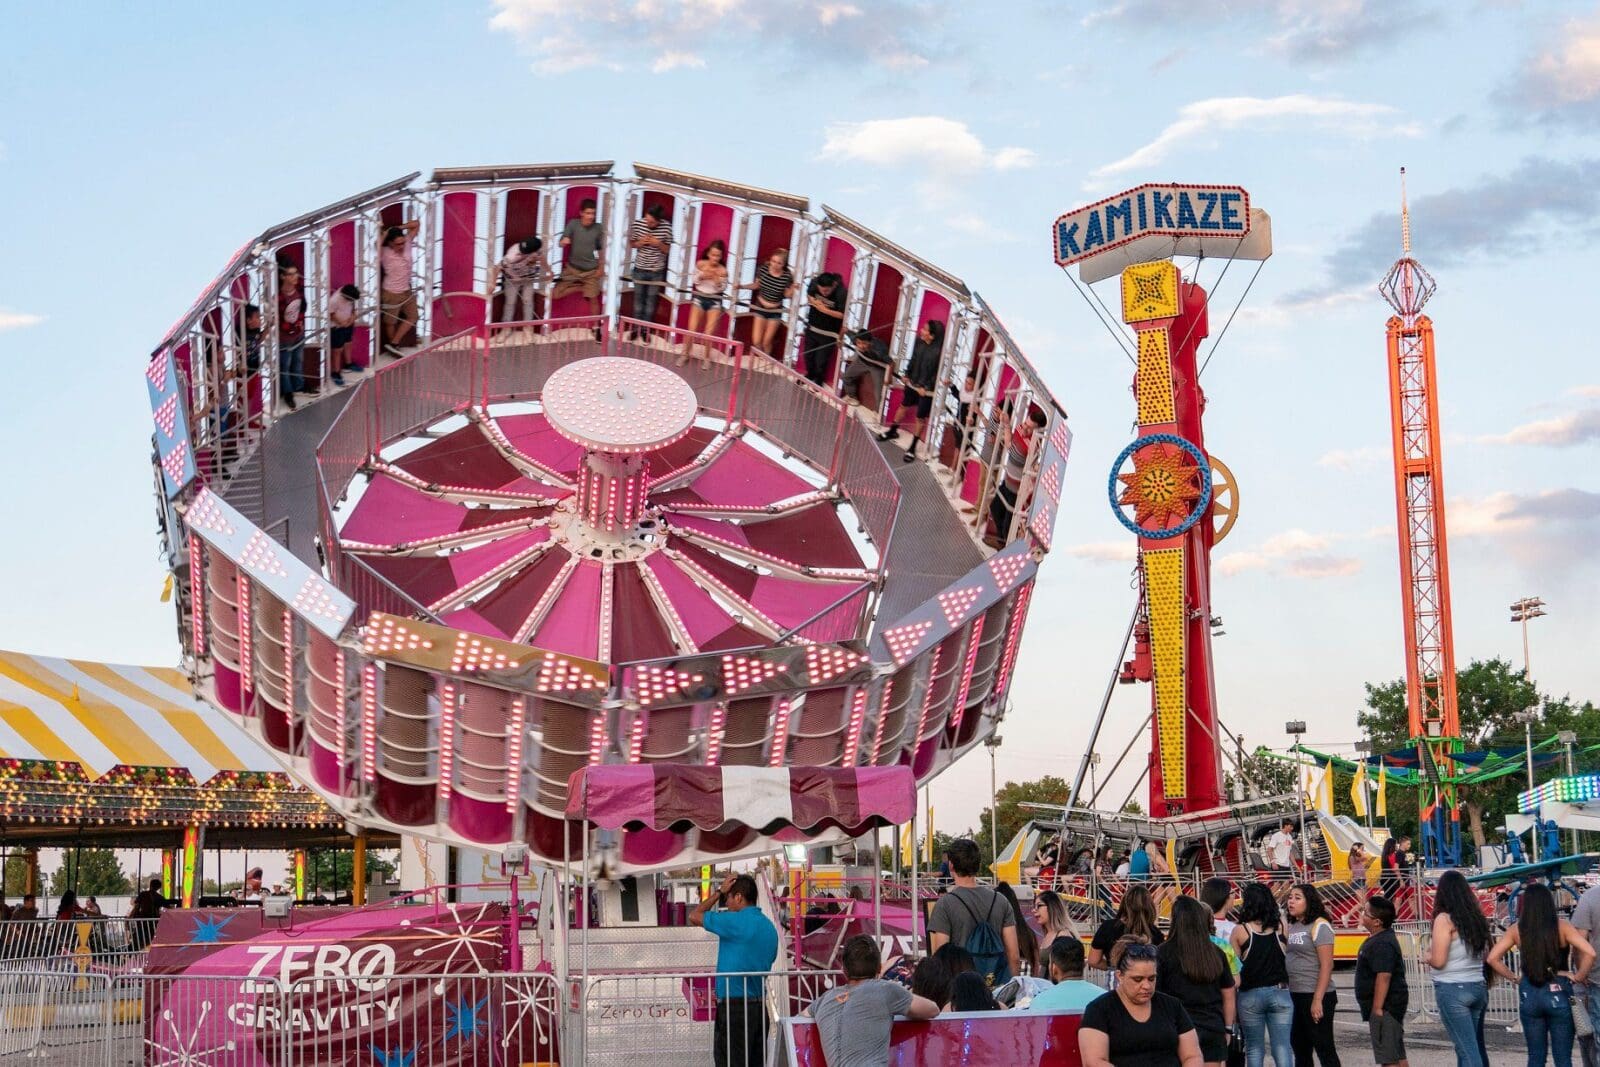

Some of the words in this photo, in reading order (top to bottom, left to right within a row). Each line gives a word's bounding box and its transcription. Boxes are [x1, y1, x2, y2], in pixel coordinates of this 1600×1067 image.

[1058, 191, 1243, 260] KAMIKAZE
[227, 996, 401, 1032] GRAVITY
[600, 1004, 643, 1019] Zero
[648, 1004, 688, 1019] Gra
